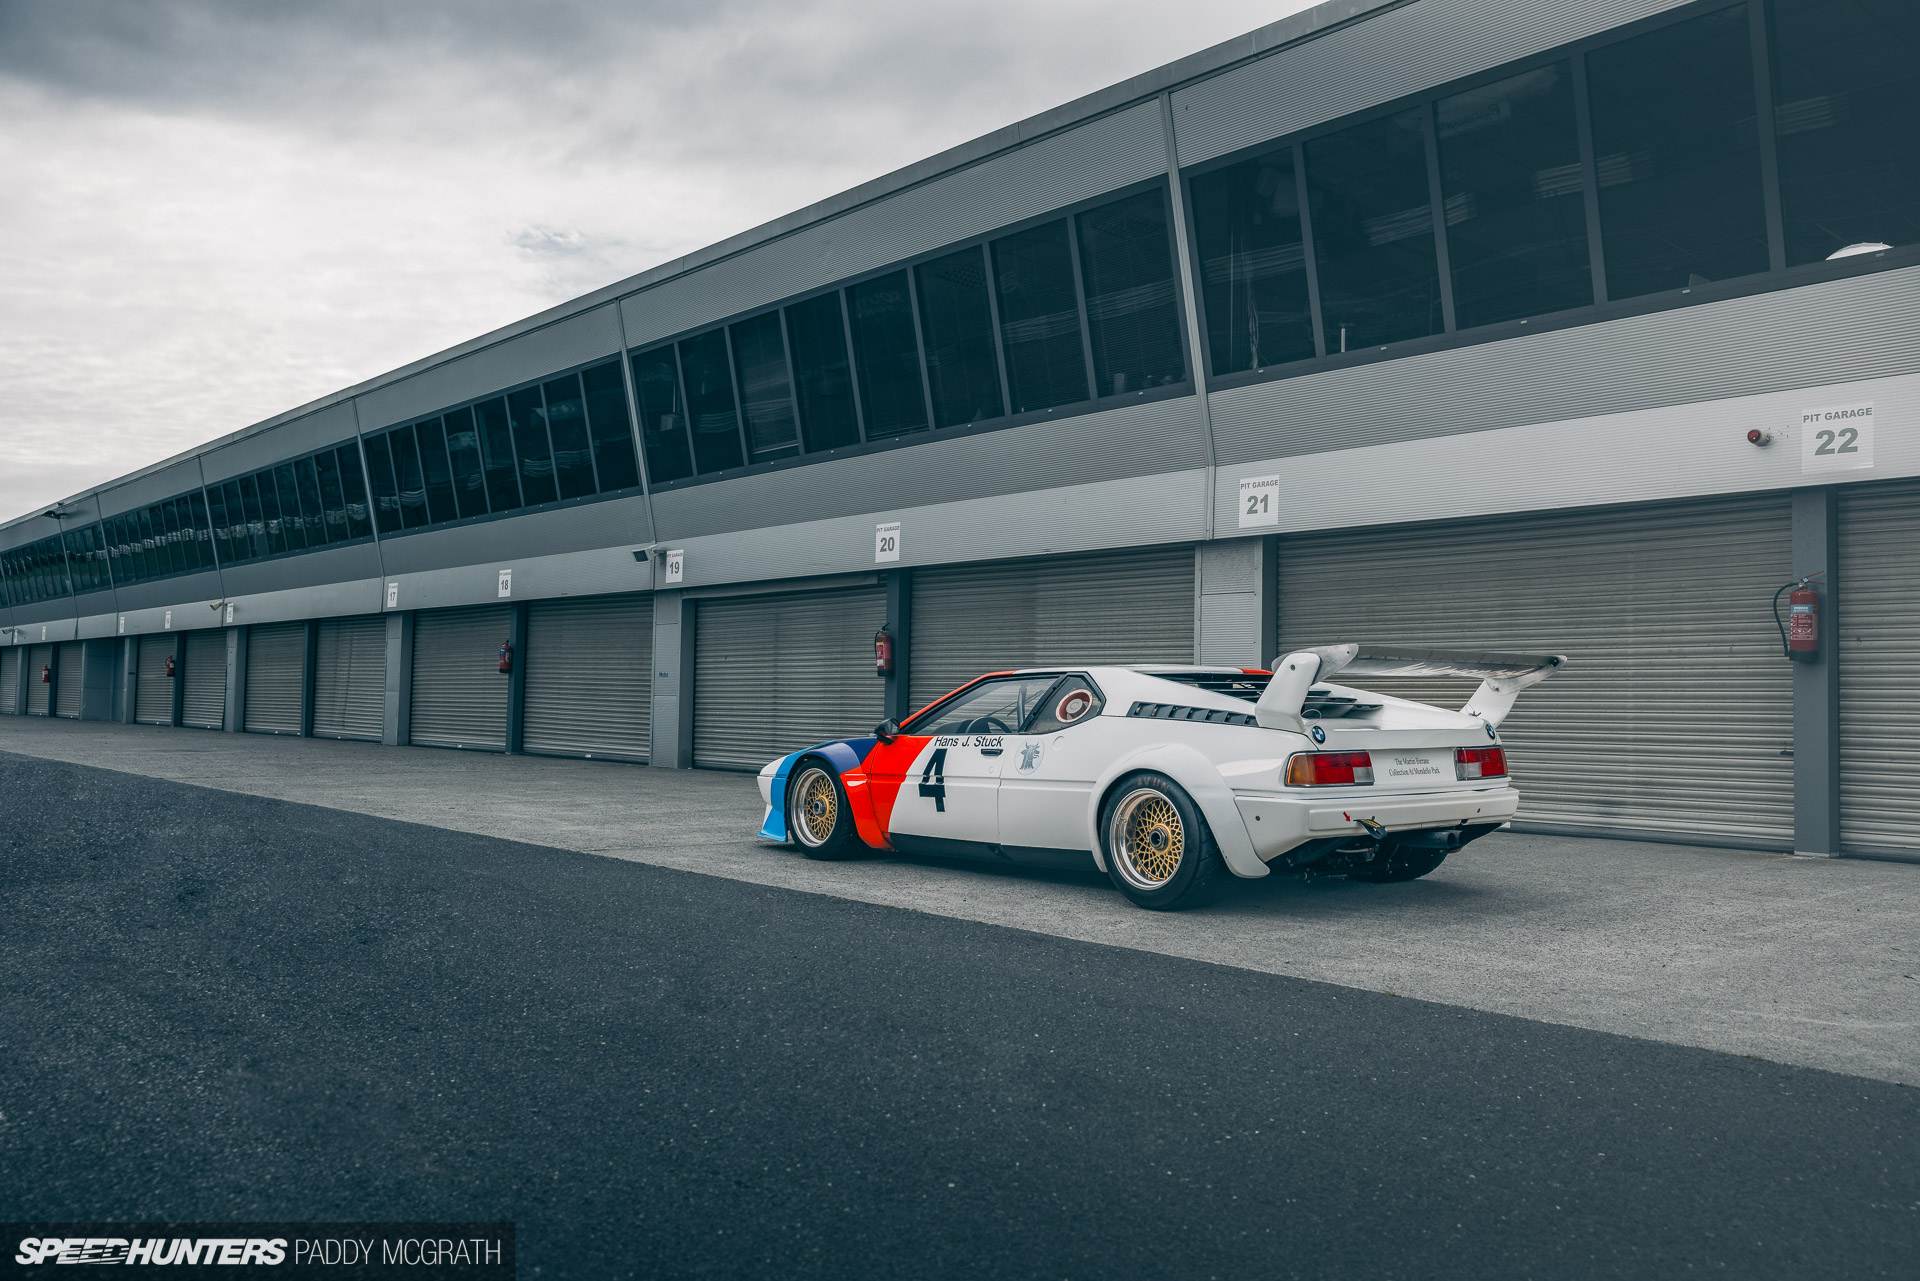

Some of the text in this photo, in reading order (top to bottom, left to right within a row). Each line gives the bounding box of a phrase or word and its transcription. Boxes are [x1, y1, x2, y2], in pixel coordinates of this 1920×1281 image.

[1802, 407, 1873, 424] PIT GARAGE
[1814, 427, 1859, 456] 22
[1240, 479, 1279, 490] PIT GARAGE
[1246, 493, 1269, 515] 21
[879, 536, 895, 552] 20
[669, 561, 680, 575] 19
[500, 579, 509, 591] 18
[389, 591, 396, 601] 17
[934, 736, 1004, 747] Hans J. Stuck
[1394, 757, 1403, 766] The
[1388, 768, 1410, 777] Collection
[1431, 766, 1441, 774] Park
[918, 748, 948, 813] 4
